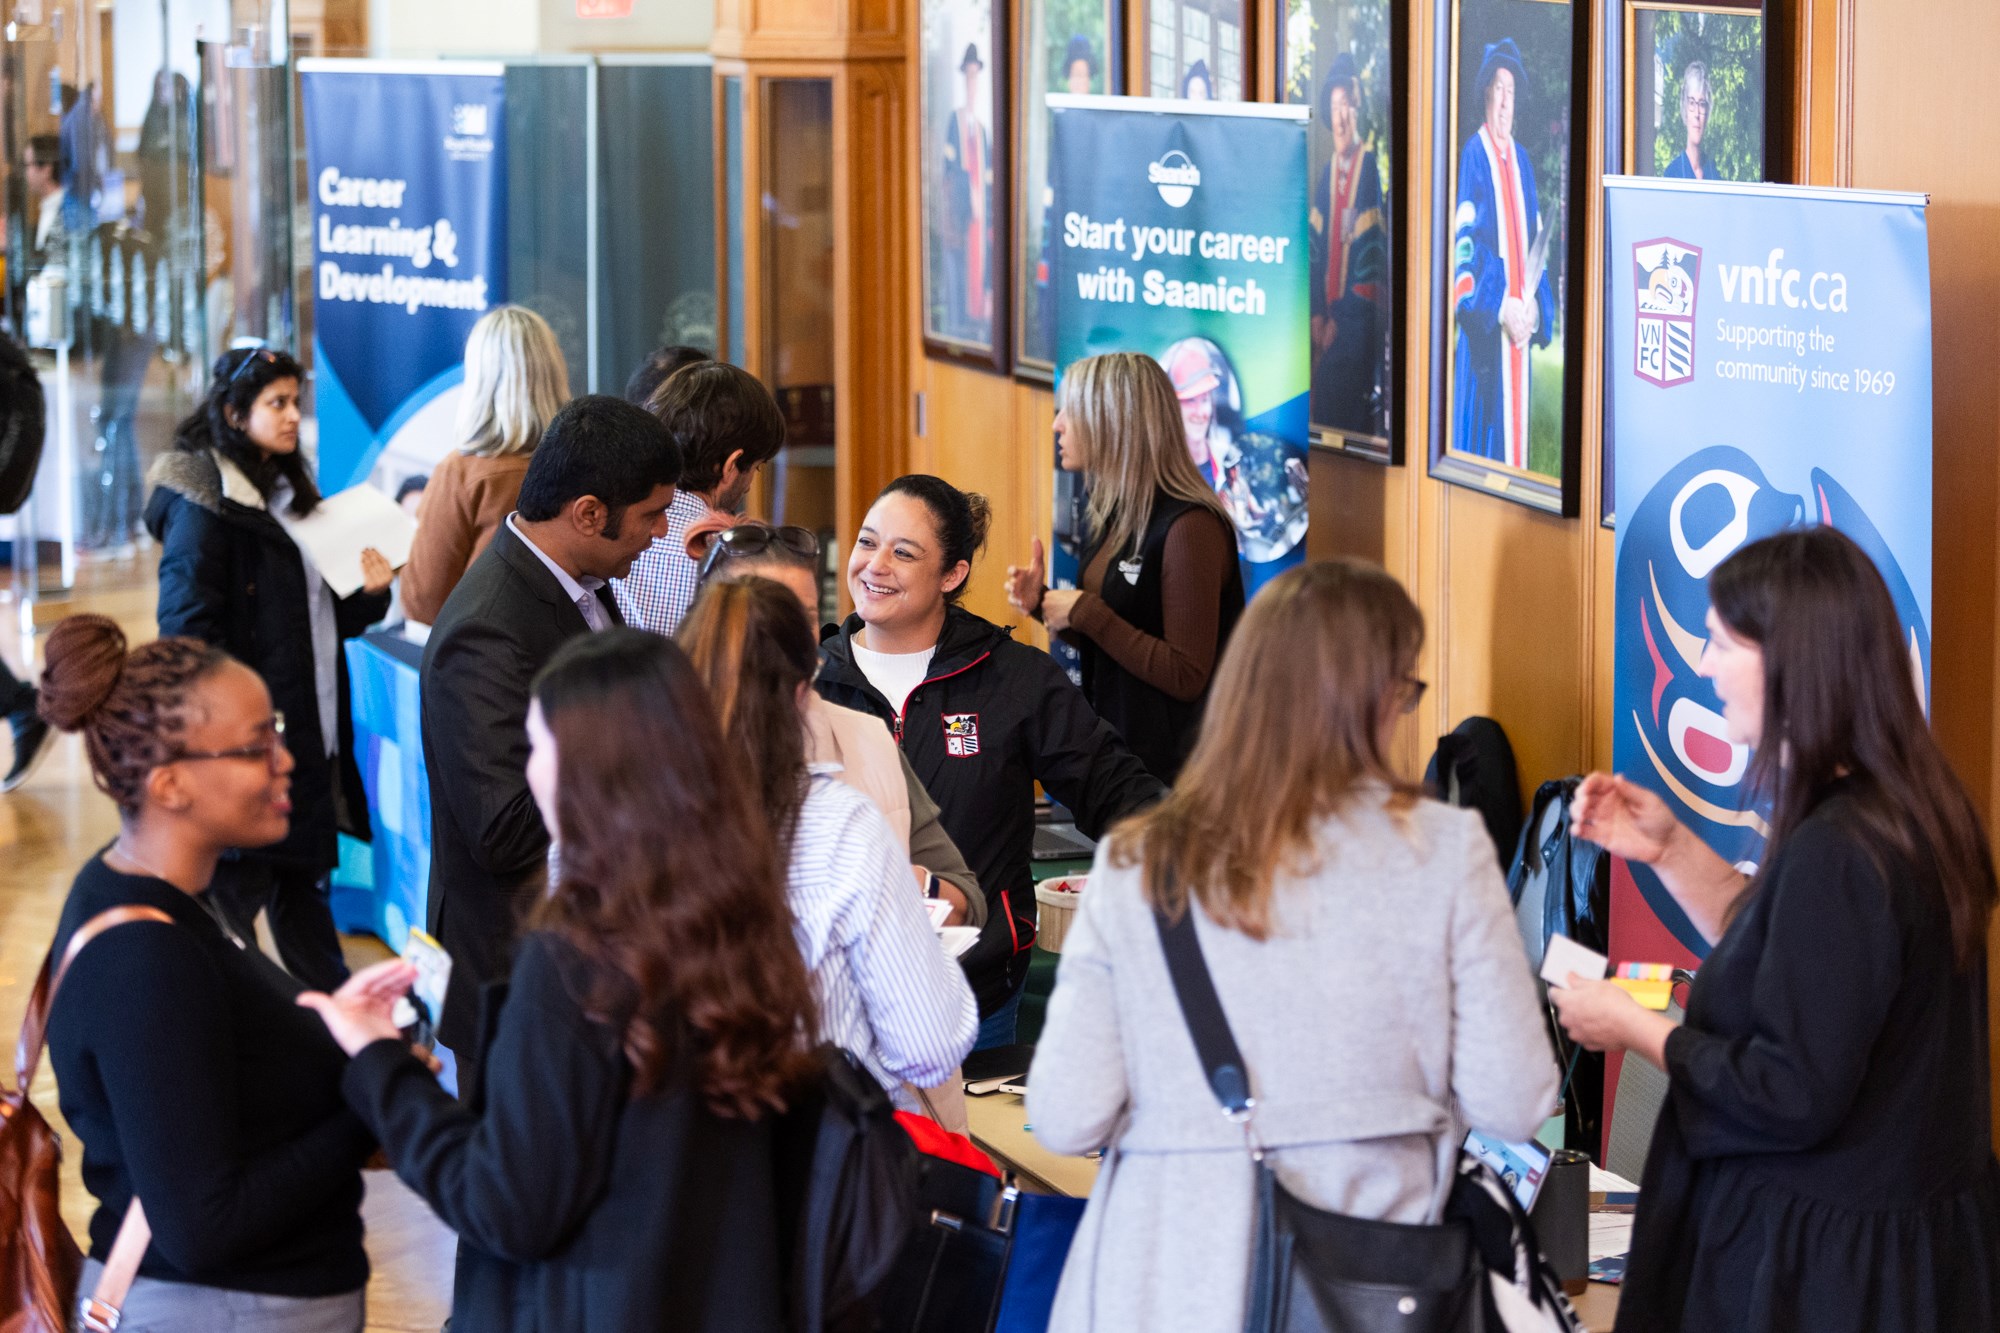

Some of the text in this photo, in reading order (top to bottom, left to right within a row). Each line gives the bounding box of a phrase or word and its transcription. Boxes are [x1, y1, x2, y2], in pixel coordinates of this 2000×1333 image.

[319, 167, 406, 208] Career
[1148, 161, 1200, 186] Saanich
[319, 214, 459, 268] Learning &
[1064, 211, 1290, 264] Start your career
[319, 260, 487, 315] Development
[1077, 266, 1266, 315] with Saanich
[1718, 248, 1848, 313] vnfc.ca
[1641, 323, 1660, 345] VN
[1717, 318, 1835, 357] Supporting the
[1640, 347, 1659, 371] FC
[1716, 359, 1896, 396] community since 1969
